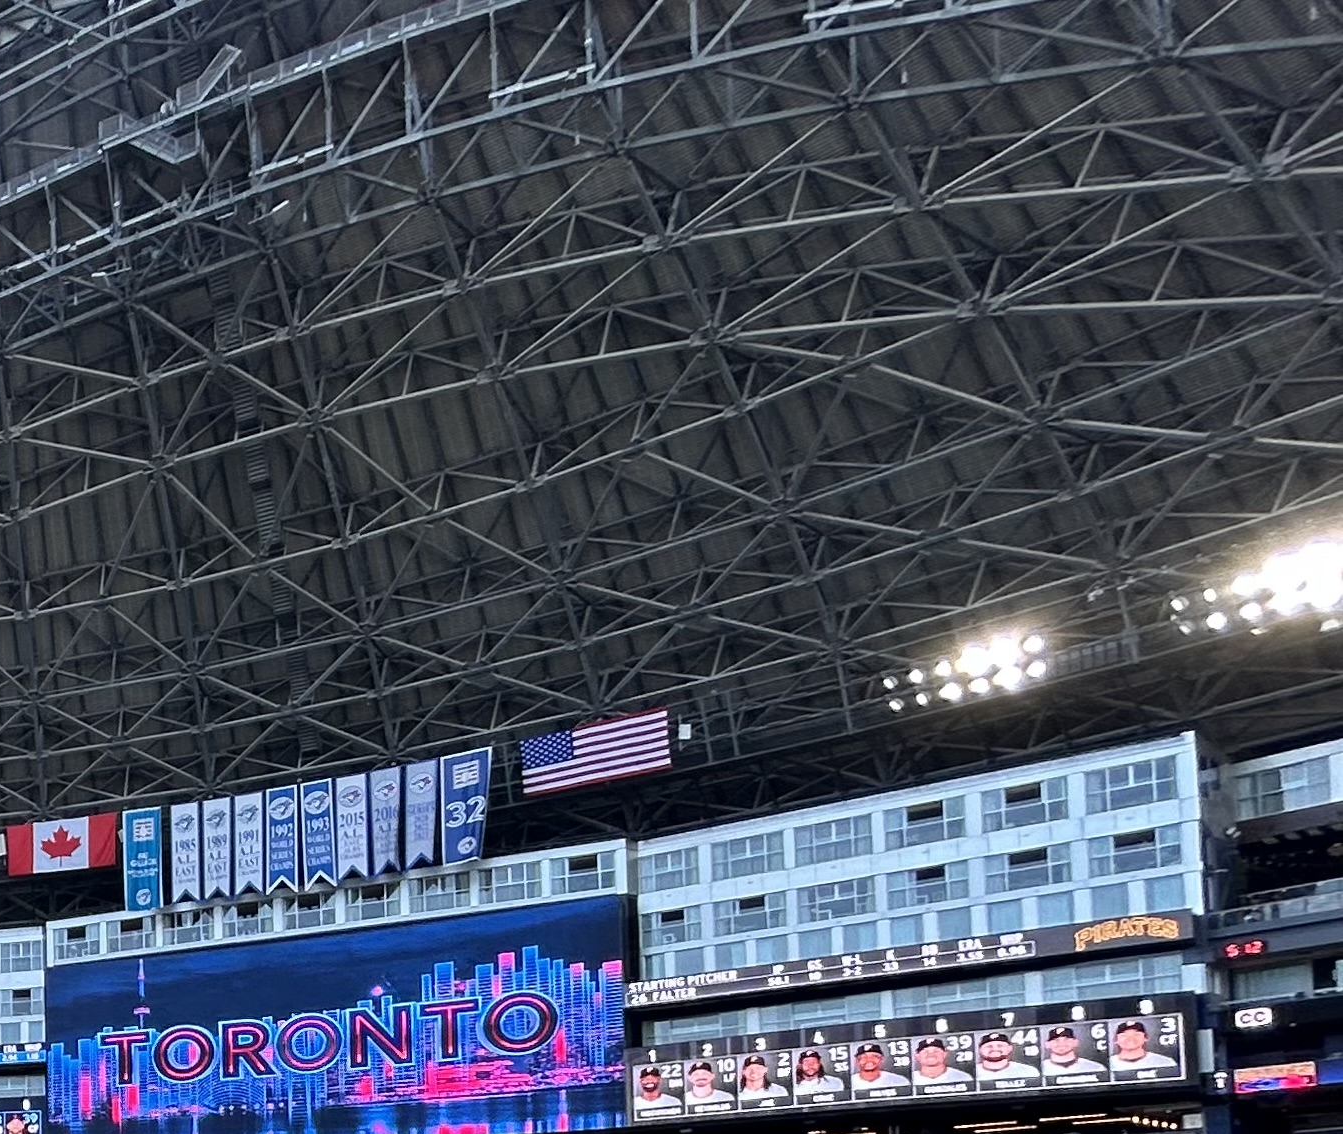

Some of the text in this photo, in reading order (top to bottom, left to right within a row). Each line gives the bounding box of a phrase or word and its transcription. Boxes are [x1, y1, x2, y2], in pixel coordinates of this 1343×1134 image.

[446, 795, 485, 828] 32
[307, 817, 329, 833] 1993
[340, 812, 364, 828] 2015
[238, 829, 259, 844] 1991
[270, 823, 294, 839] 1992
[175, 839, 196, 853] 1985
[1073, 916, 1179, 951] PIRATES
[628, 977, 685, 995] STARTING
[687, 970, 738, 988] PITCHER
[631, 994, 648, 1006] 26
[652, 988, 697, 1001] FALTER
[1000, 1011, 1015, 1027] 7
[1161, 1018, 1176, 1033] 3
[1240, 1011, 1266, 1025] CC
[99, 990, 561, 1087] TORONTO
[813, 1031, 826, 1045] 4
[873, 1024, 887, 1038] 5
[1012, 1029, 1038, 1046] 44
[1091, 1023, 1107, 1039] 6
[702, 1043, 713, 1057] 2
[754, 1037, 767, 1051] 3
[888, 1041, 909, 1056] 13
[946, 1035, 973, 1051] 39
[1097, 1040, 1108, 1051] C
[648, 1049, 657, 1063] 1
[777, 1052, 791, 1067] 2
[828, 1046, 849, 1062] 15
[661, 1064, 683, 1079] 22
[716, 1058, 737, 1073] 10
[23, 1113, 39, 1125] 39
